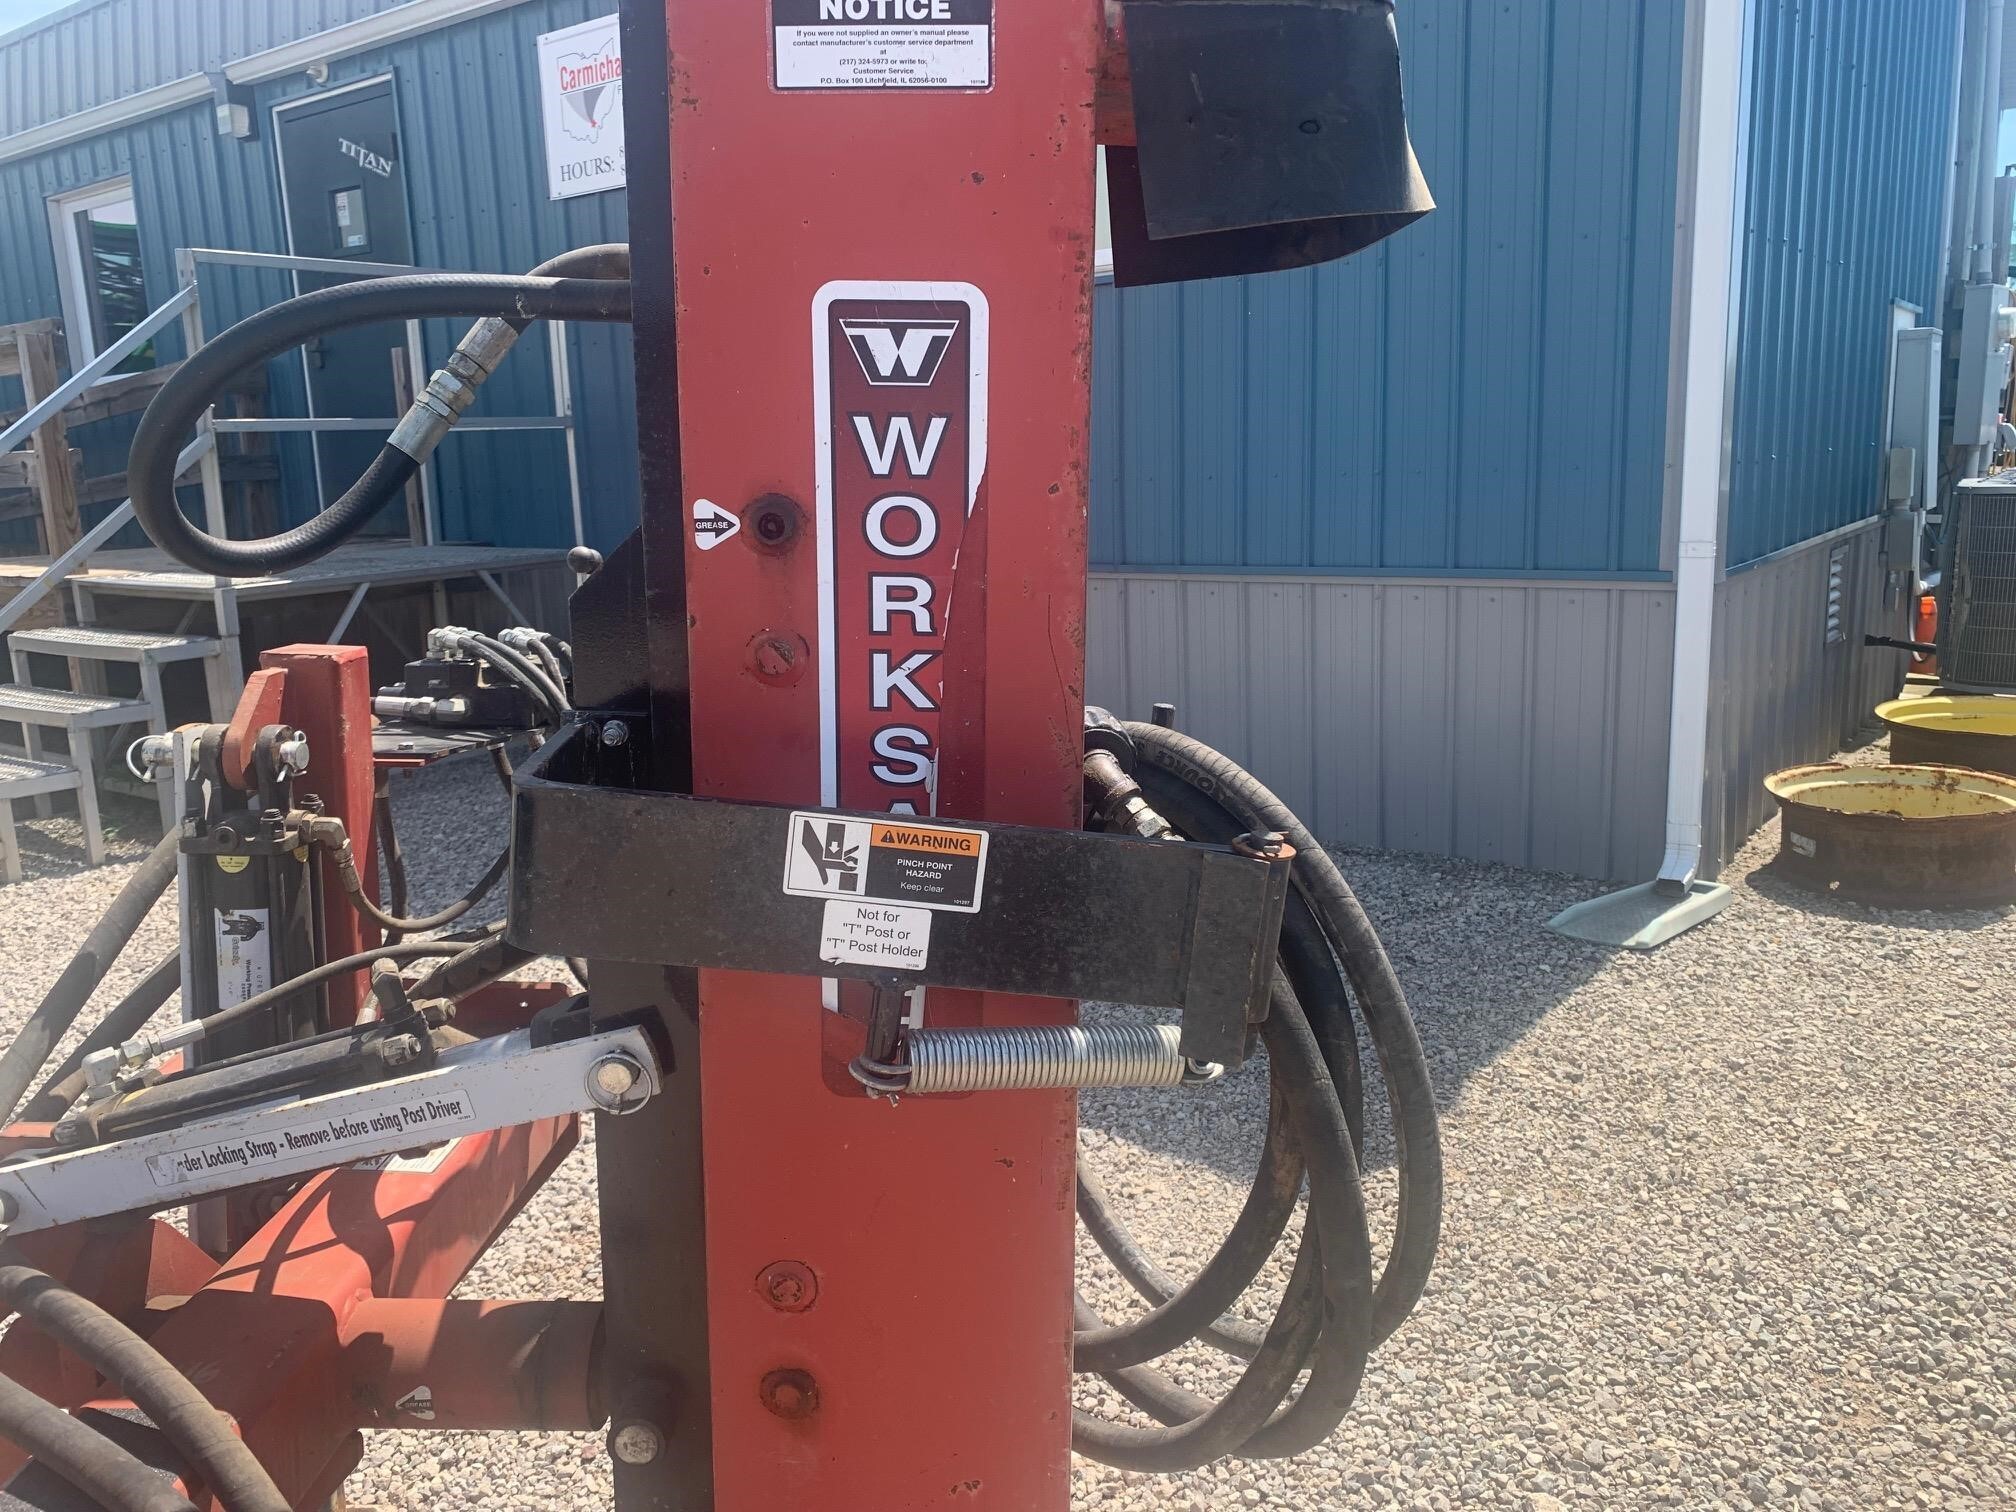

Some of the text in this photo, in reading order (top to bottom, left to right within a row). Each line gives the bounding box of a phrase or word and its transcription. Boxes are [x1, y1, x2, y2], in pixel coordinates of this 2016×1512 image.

[819, 0, 952, 20] NOTICE
[849, 29, 879, 37] supplied
[946, 29, 970, 37] please
[839, 58, 857, 66] (217)
[853, 67, 887, 75] Customer
[338, 138, 392, 174] TITAN
[560, 155, 615, 182] HOURS:
[695, 521, 729, 529] GREASE
[852, 416, 947, 816] WORKS
[896, 832, 971, 851] WARNING
[897, 858, 953, 871] PINCH POINT
[906, 869, 942, 879] HAZARD
[900, 881, 945, 893] Keep clear
[857, 907, 900, 923] Not for
[842, 922, 911, 940] "T" Post or
[826, 937, 923, 958] "T" Post Holder
[201, 1146, 248, 1168] Locking
[245, 1140, 278, 1158] Strap
[284, 1130, 331, 1150] Remove
[329, 1118, 369, 1141] before
[370, 1112, 403, 1132] using
[400, 1105, 427, 1125] Post
[425, 1100, 462, 1120] Driver
